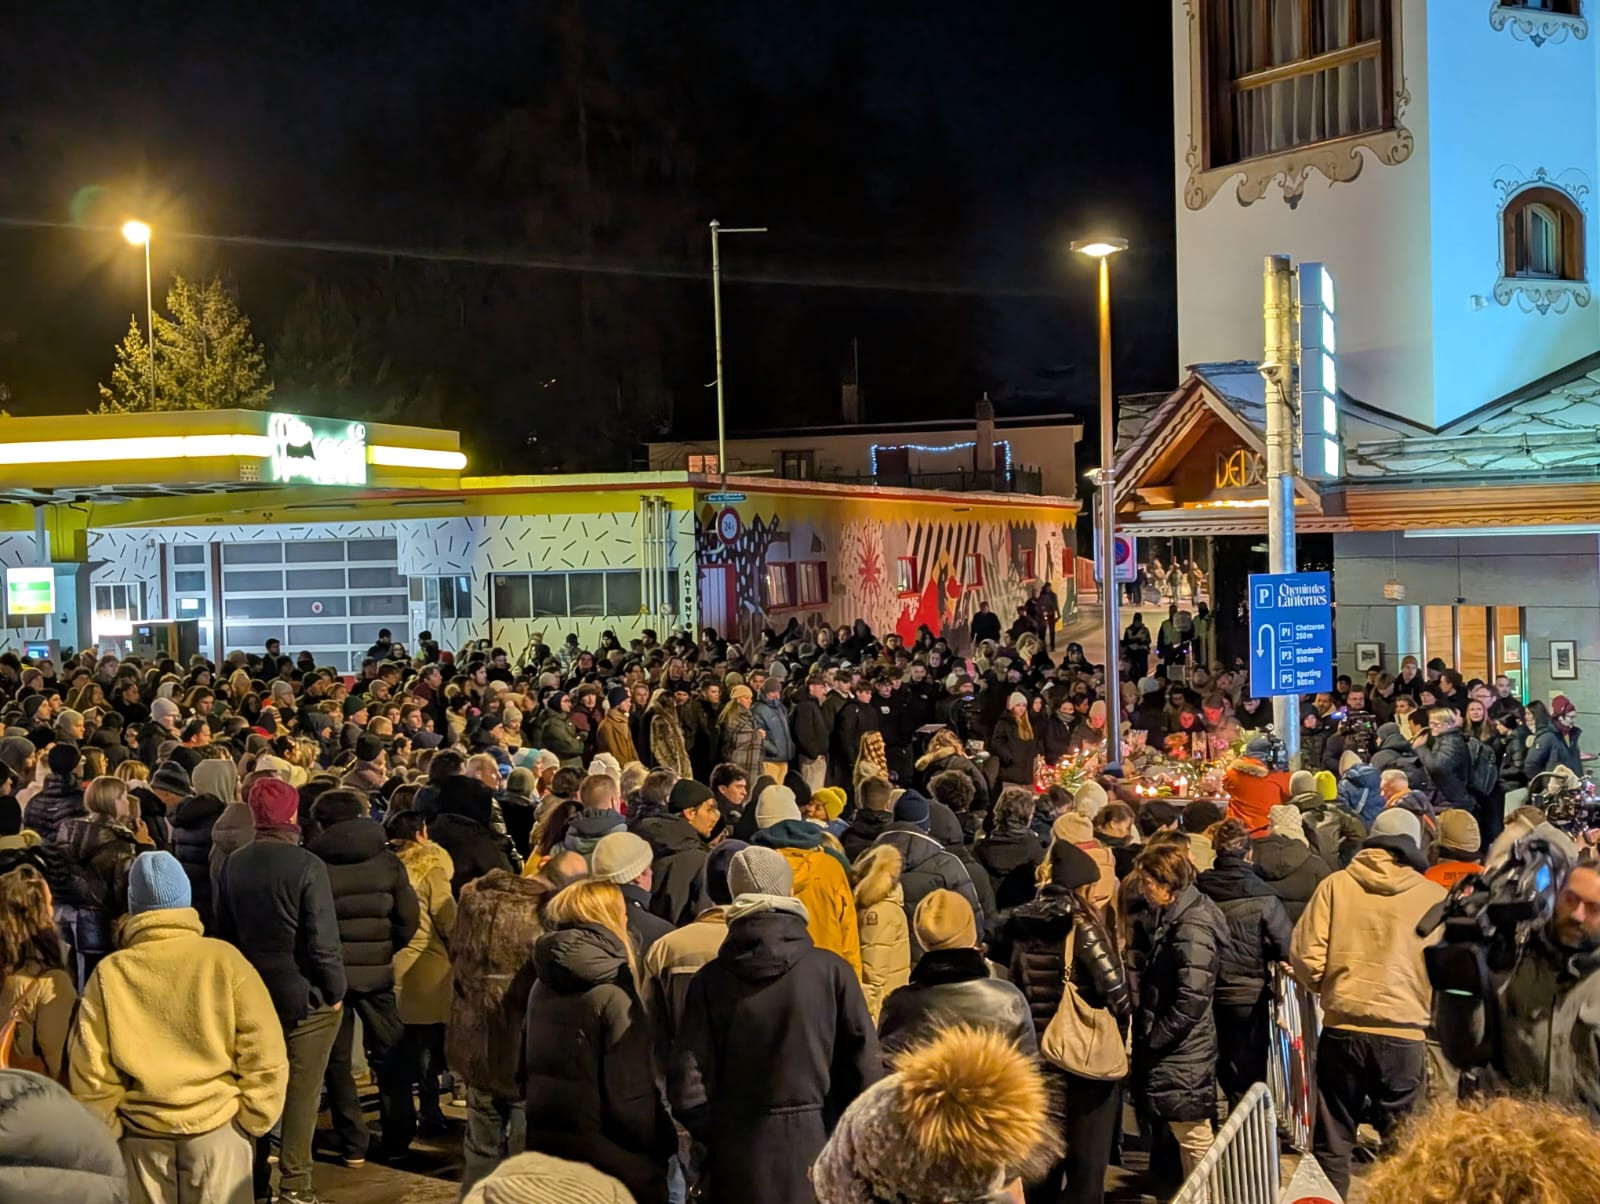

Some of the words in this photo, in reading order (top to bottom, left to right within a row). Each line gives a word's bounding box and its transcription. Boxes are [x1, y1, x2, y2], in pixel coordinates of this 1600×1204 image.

[1259, 588, 1270, 604] P
[1278, 595, 1327, 608] Lanternes
[1282, 627, 1291, 637] P1
[1282, 651, 1292, 660] P3
[1282, 674, 1292, 683] P5
[1297, 669, 1321, 679] Sporting
